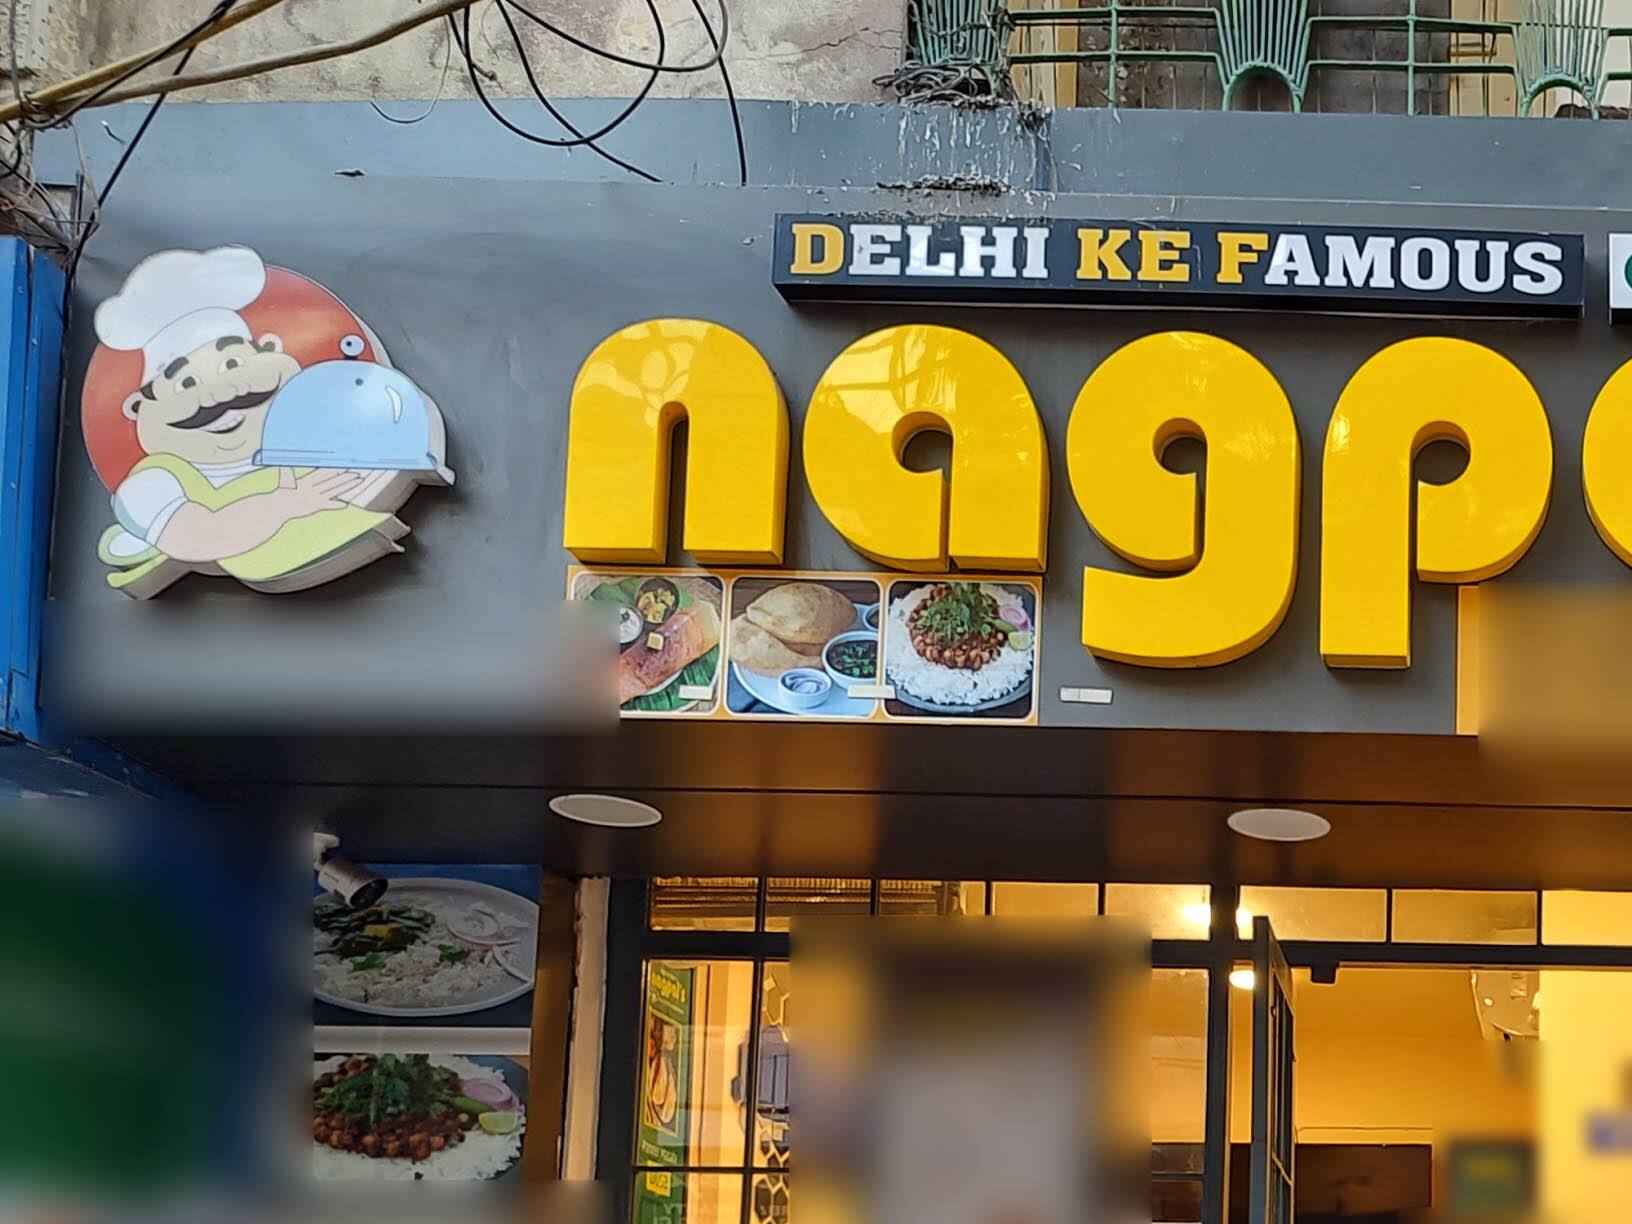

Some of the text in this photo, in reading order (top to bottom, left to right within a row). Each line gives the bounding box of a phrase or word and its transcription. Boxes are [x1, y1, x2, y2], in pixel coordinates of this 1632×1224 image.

[789, 222, 1565, 295] DELHI KE FAMOUS
